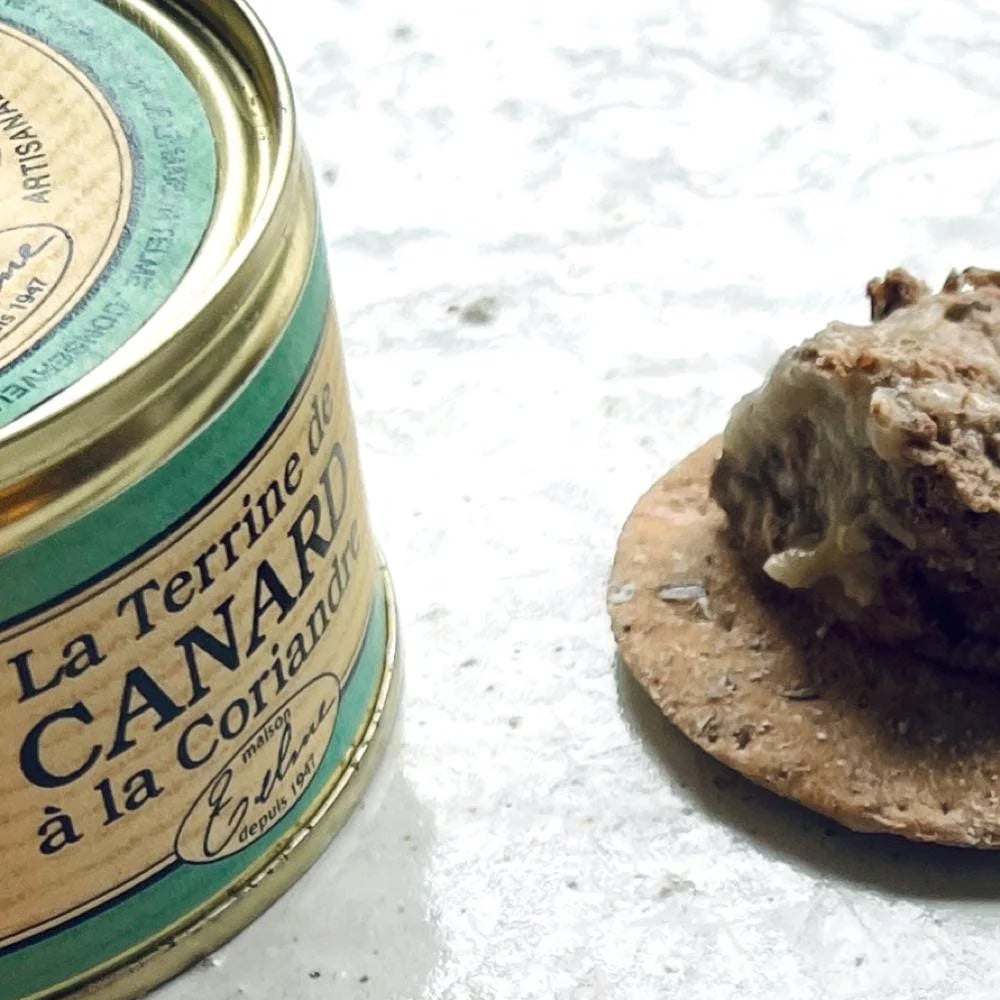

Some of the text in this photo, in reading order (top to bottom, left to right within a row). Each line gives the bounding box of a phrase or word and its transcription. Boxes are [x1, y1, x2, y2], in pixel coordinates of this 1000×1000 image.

[0, 93, 51, 204] ARTISANA
[9, 277, 48, 310] 1947
[7, 383, 333, 704] La Terrine de
[19, 441, 347, 788] CANARD
[241, 708, 292, 764] maison
[37, 805, 84, 855] à
[94, 768, 165, 826] la
[238, 753, 316, 844] depuis 1947
